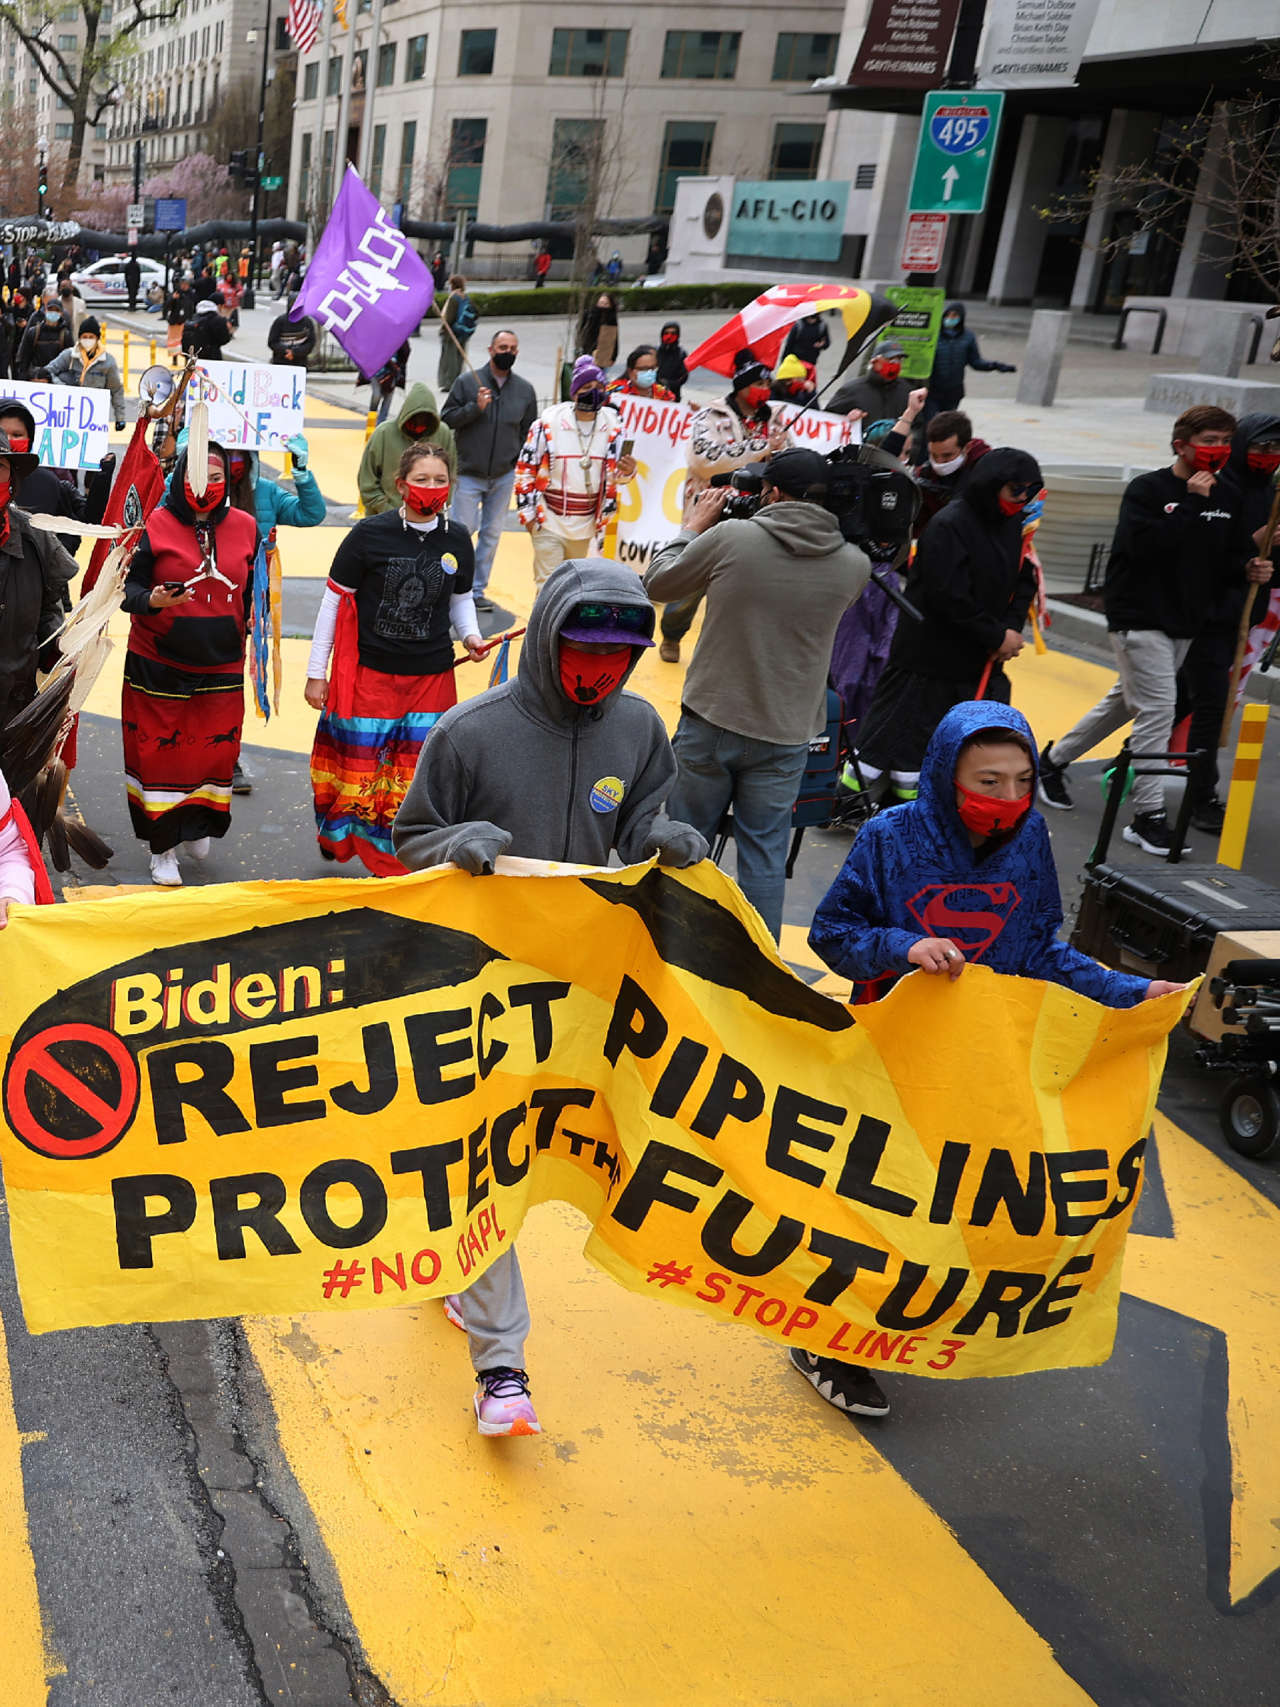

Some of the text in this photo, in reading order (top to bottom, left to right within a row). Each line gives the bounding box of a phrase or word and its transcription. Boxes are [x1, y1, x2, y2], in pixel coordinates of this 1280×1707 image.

[938, 119, 981, 146] 495
[736, 199, 837, 221] AFL-CIO
[105, 281, 149, 289] POLE
[254, 369, 303, 411] Back
[256, 412, 298, 446] Fre
[620, 400, 694, 448] INDIGE
[32, 428, 101, 470] APL
[619, 540, 668, 564] COVE
[110, 958, 345, 1036] Biden:
[146, 973, 1148, 1237] REJECT PIPELINES
[111, 1088, 596, 1270] PROTECT
[611, 1140, 1095, 1339] FUTURE
[321, 1202, 506, 1299] #NO DAPL
[646, 1260, 967, 1370] #STOP LINE 3
